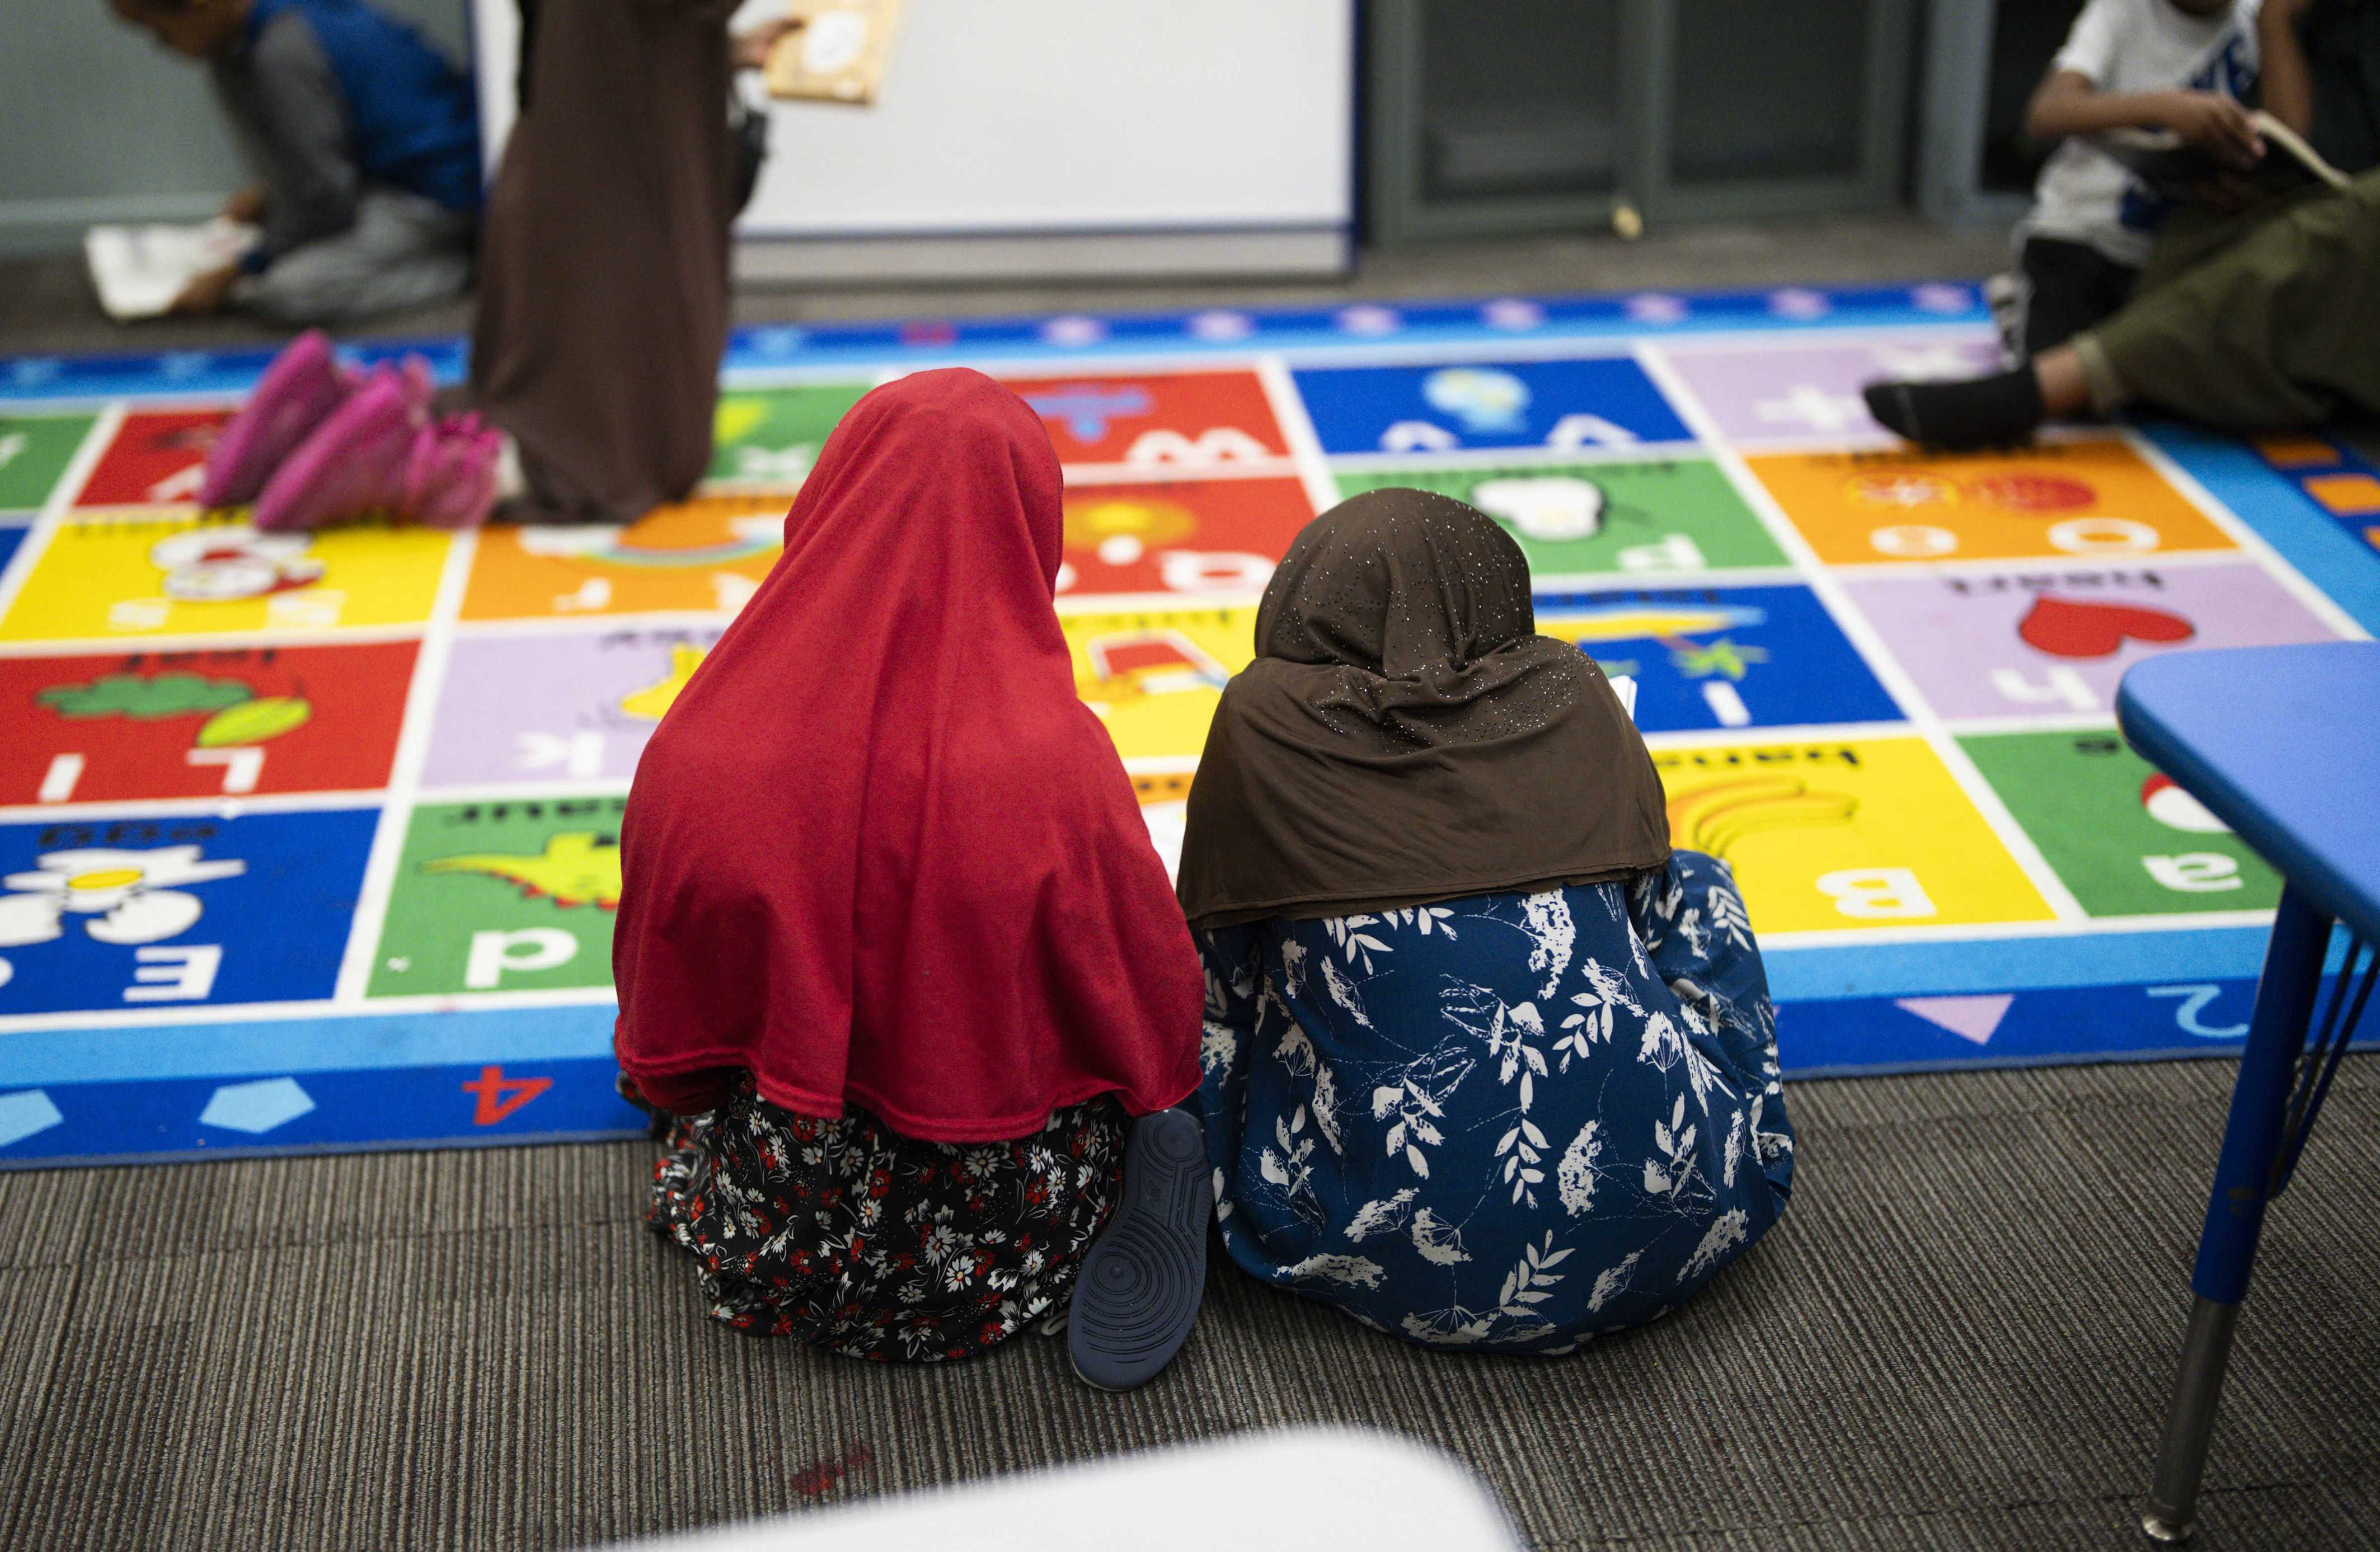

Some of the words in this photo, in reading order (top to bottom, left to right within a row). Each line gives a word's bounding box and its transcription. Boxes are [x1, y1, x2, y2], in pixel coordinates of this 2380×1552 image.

[2046, 518, 2160, 554] O
[1991, 666, 2101, 712] h
[185, 746, 265, 792] L
[1815, 867, 1938, 918] B
[2142, 852, 2243, 892] a
[122, 943, 224, 1003] E
[464, 927, 579, 989] d
[2146, 983, 2251, 1039] 2
[461, 1066, 555, 1125] 4
